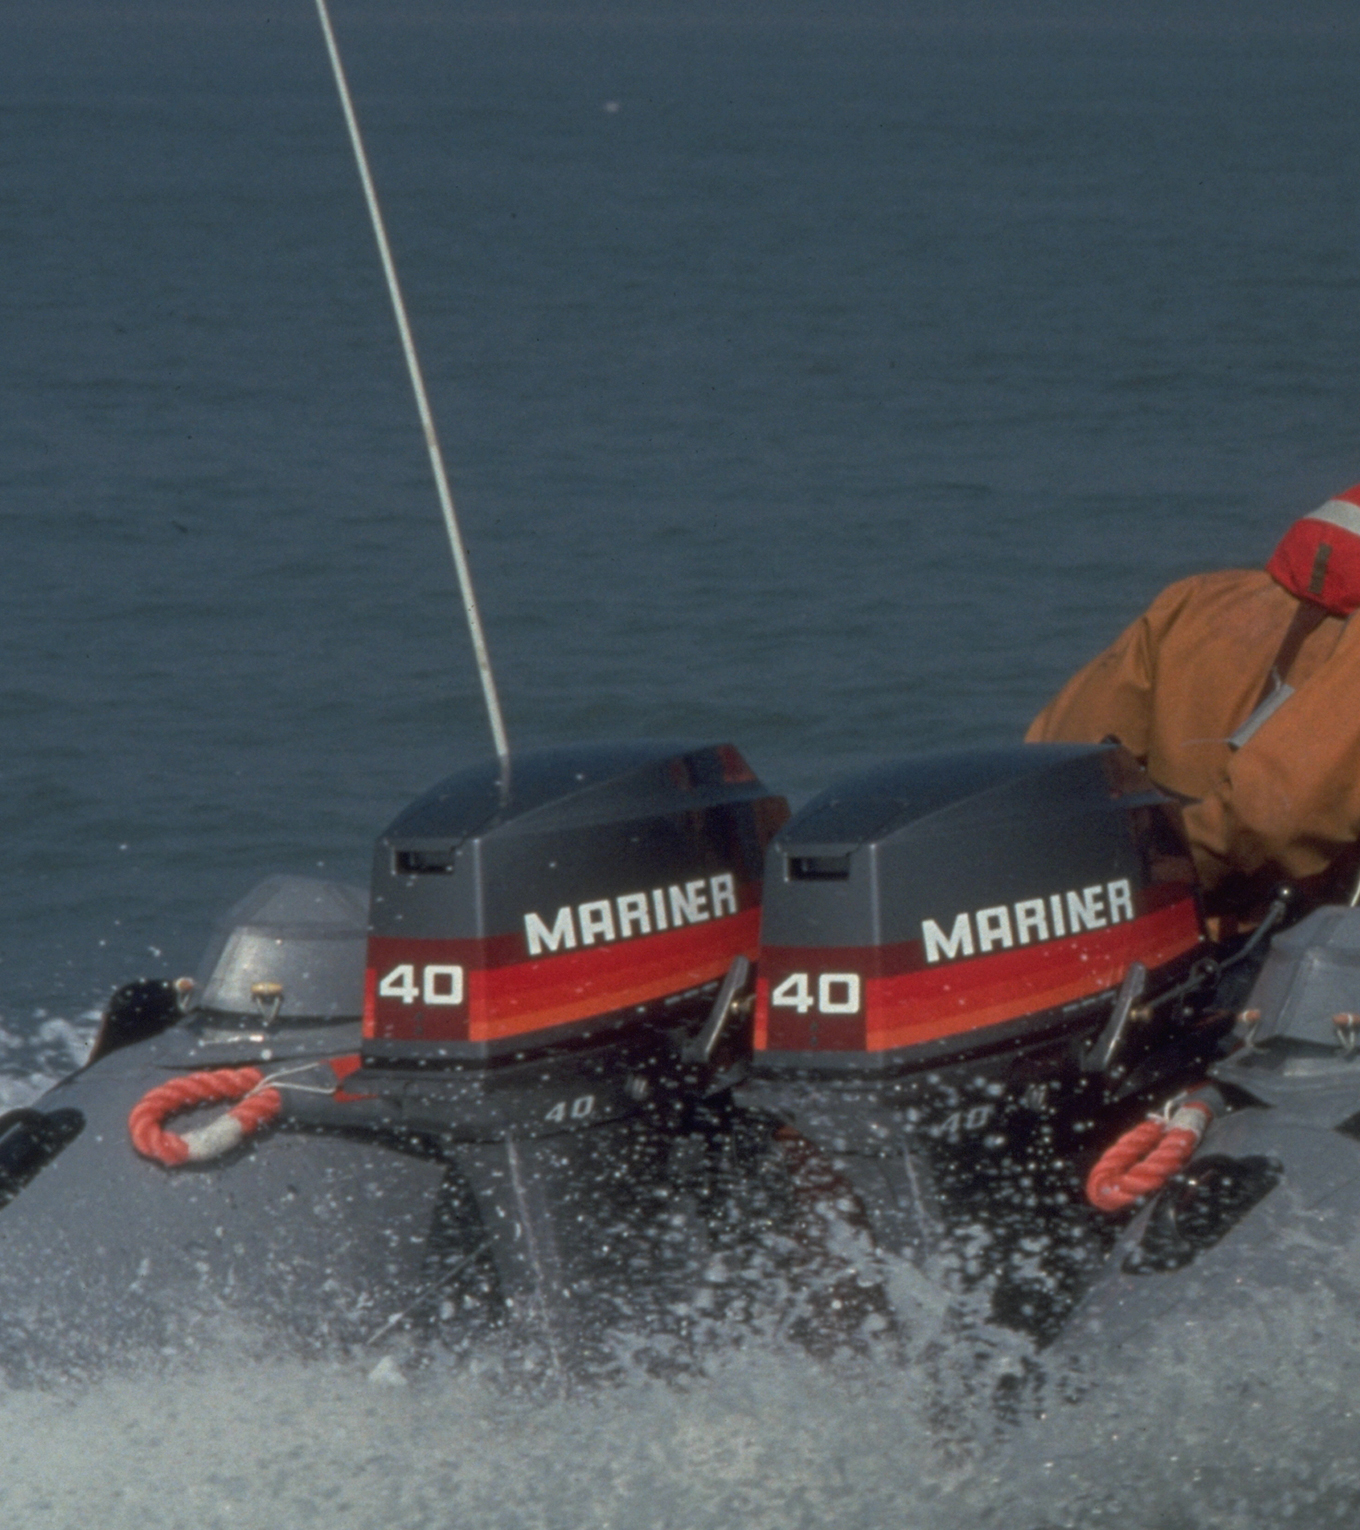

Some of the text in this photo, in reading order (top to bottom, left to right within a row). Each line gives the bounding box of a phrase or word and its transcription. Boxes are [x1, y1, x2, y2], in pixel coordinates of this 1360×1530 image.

[523, 872, 738, 956] MARINER
[921, 878, 1135, 964] MARINER
[379, 964, 464, 1005] 40
[772, 973, 861, 1014] 40
[545, 1095, 596, 1122] 40
